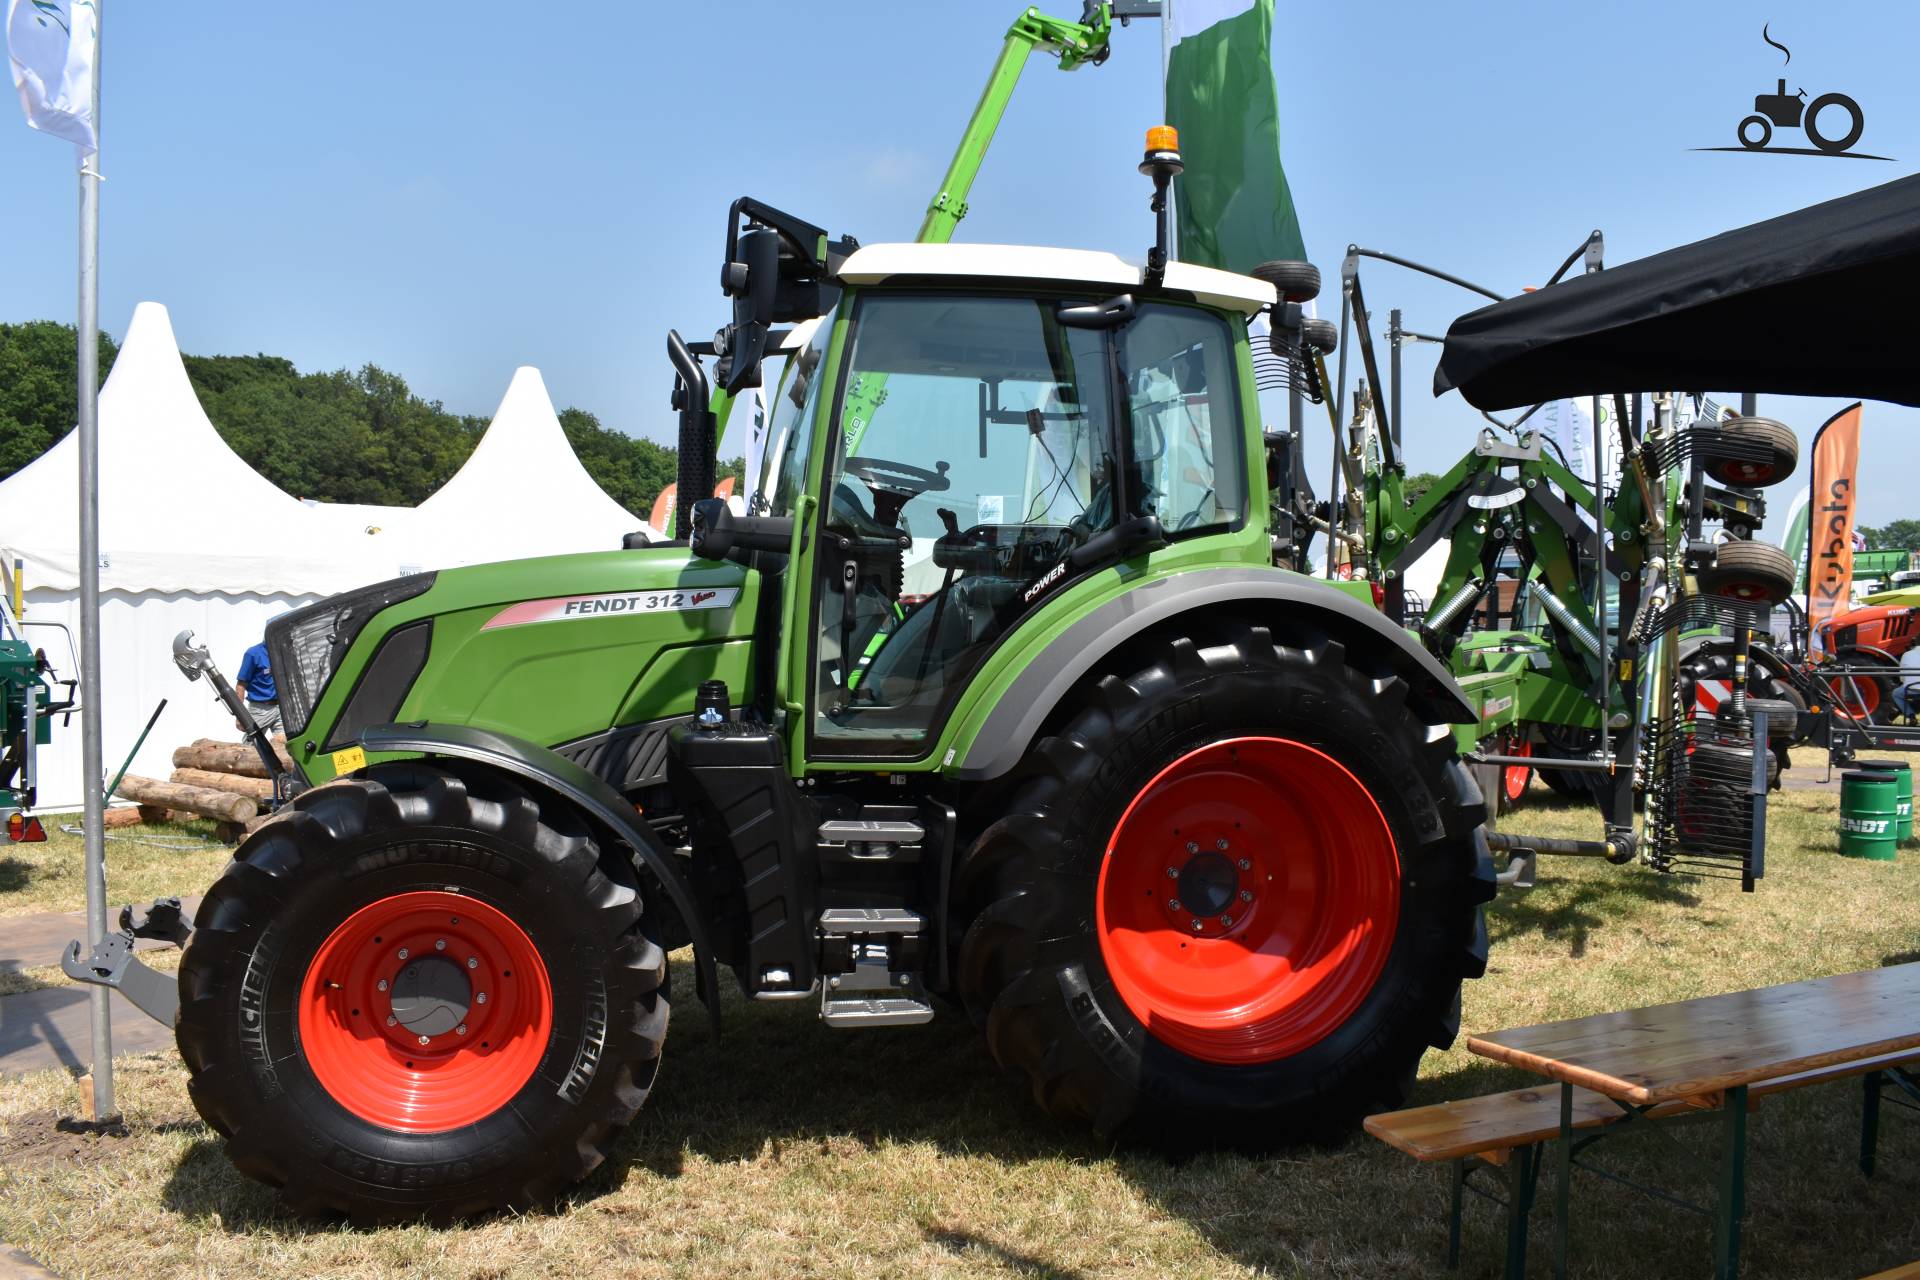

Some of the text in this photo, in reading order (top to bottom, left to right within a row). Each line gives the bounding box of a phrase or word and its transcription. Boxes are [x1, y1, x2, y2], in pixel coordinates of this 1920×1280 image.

[1817, 479, 1849, 608] Kubota
[1024, 562, 1066, 602] POWER
[565, 597, 640, 615] FENDT
[646, 593, 684, 609] 312
[1840, 817, 1889, 834] ENDT
[562, 968, 607, 1100] MICHELIN
